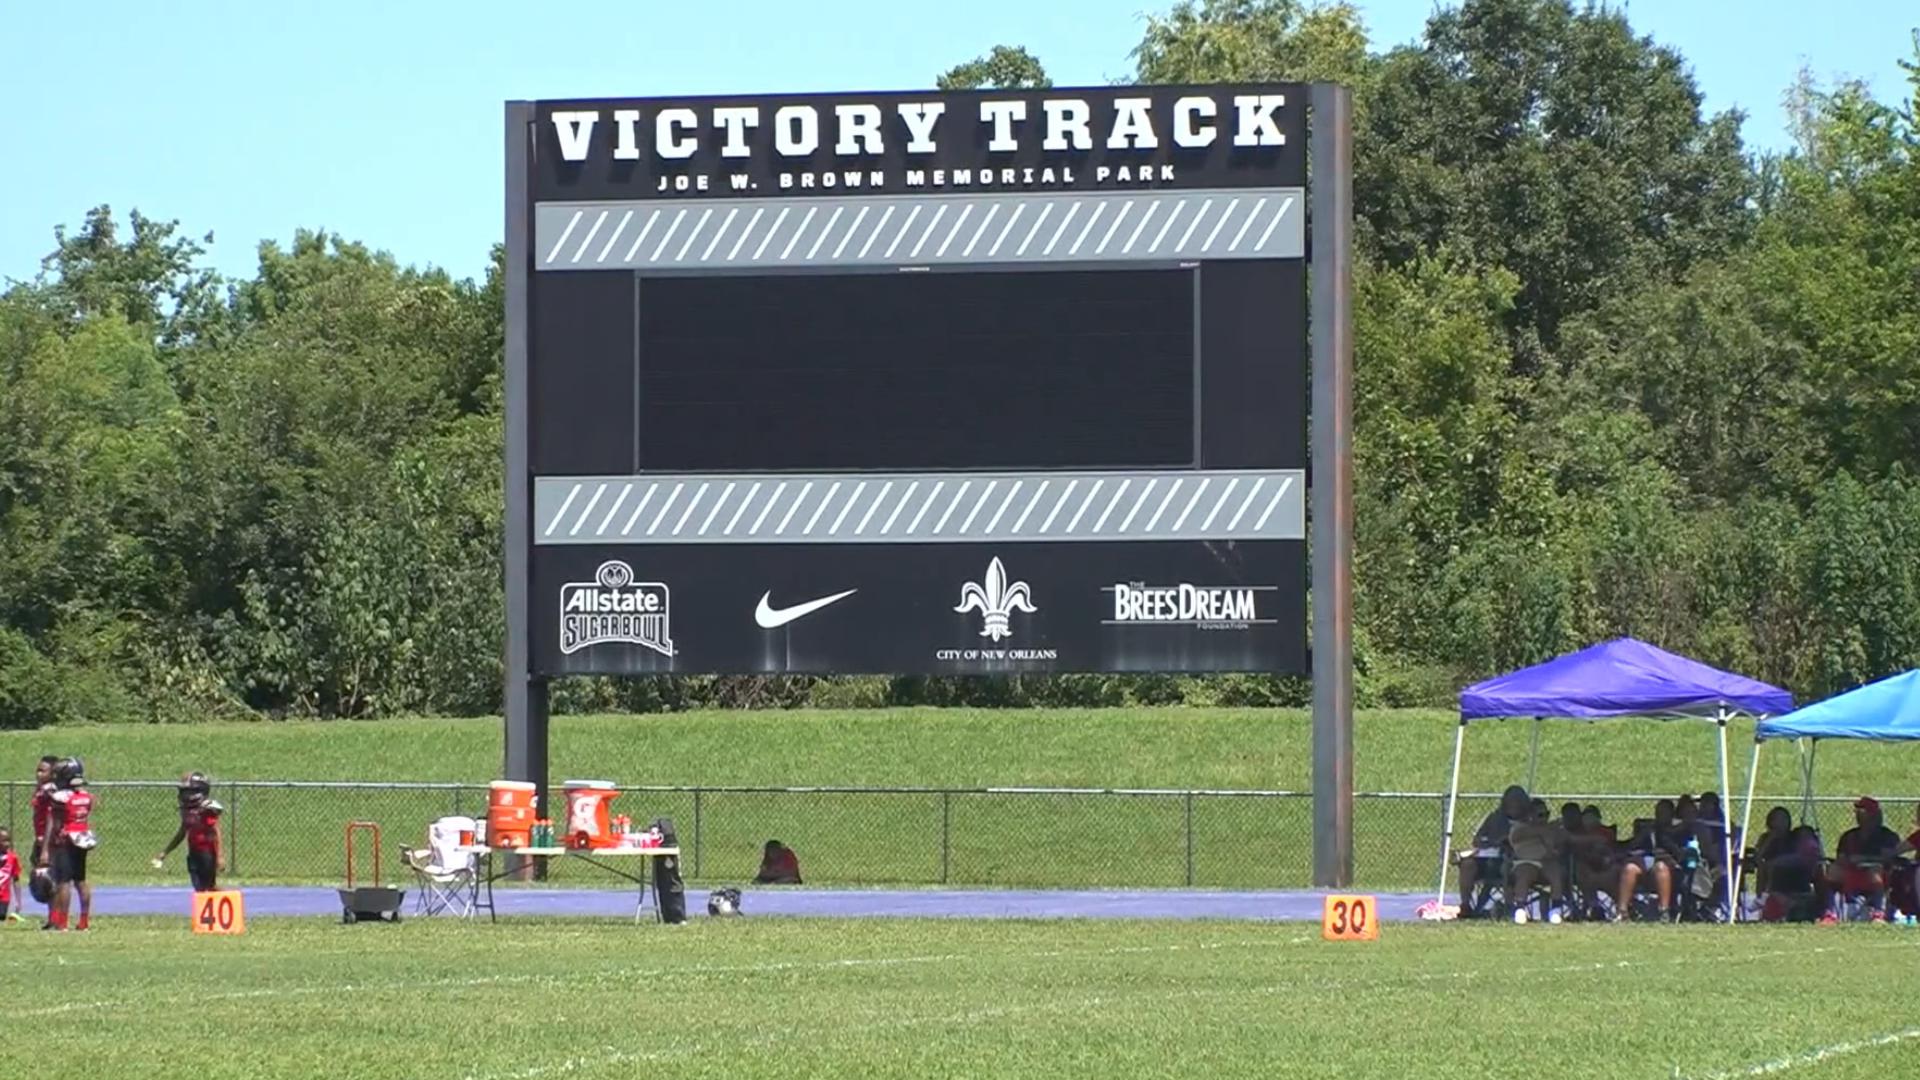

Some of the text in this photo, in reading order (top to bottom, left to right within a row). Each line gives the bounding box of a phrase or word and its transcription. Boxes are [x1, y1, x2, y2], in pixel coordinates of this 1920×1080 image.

[551, 94, 1286, 162] VICTORY TRACK
[657, 164, 1176, 192] JOE W. BROWN MEMORIAL PARK
[565, 588, 659, 612] Allstate
[936, 648, 1057, 660] CITY OF NEW ORLEANS
[200, 896, 234, 931] 40
[1332, 899, 1366, 935] 30
